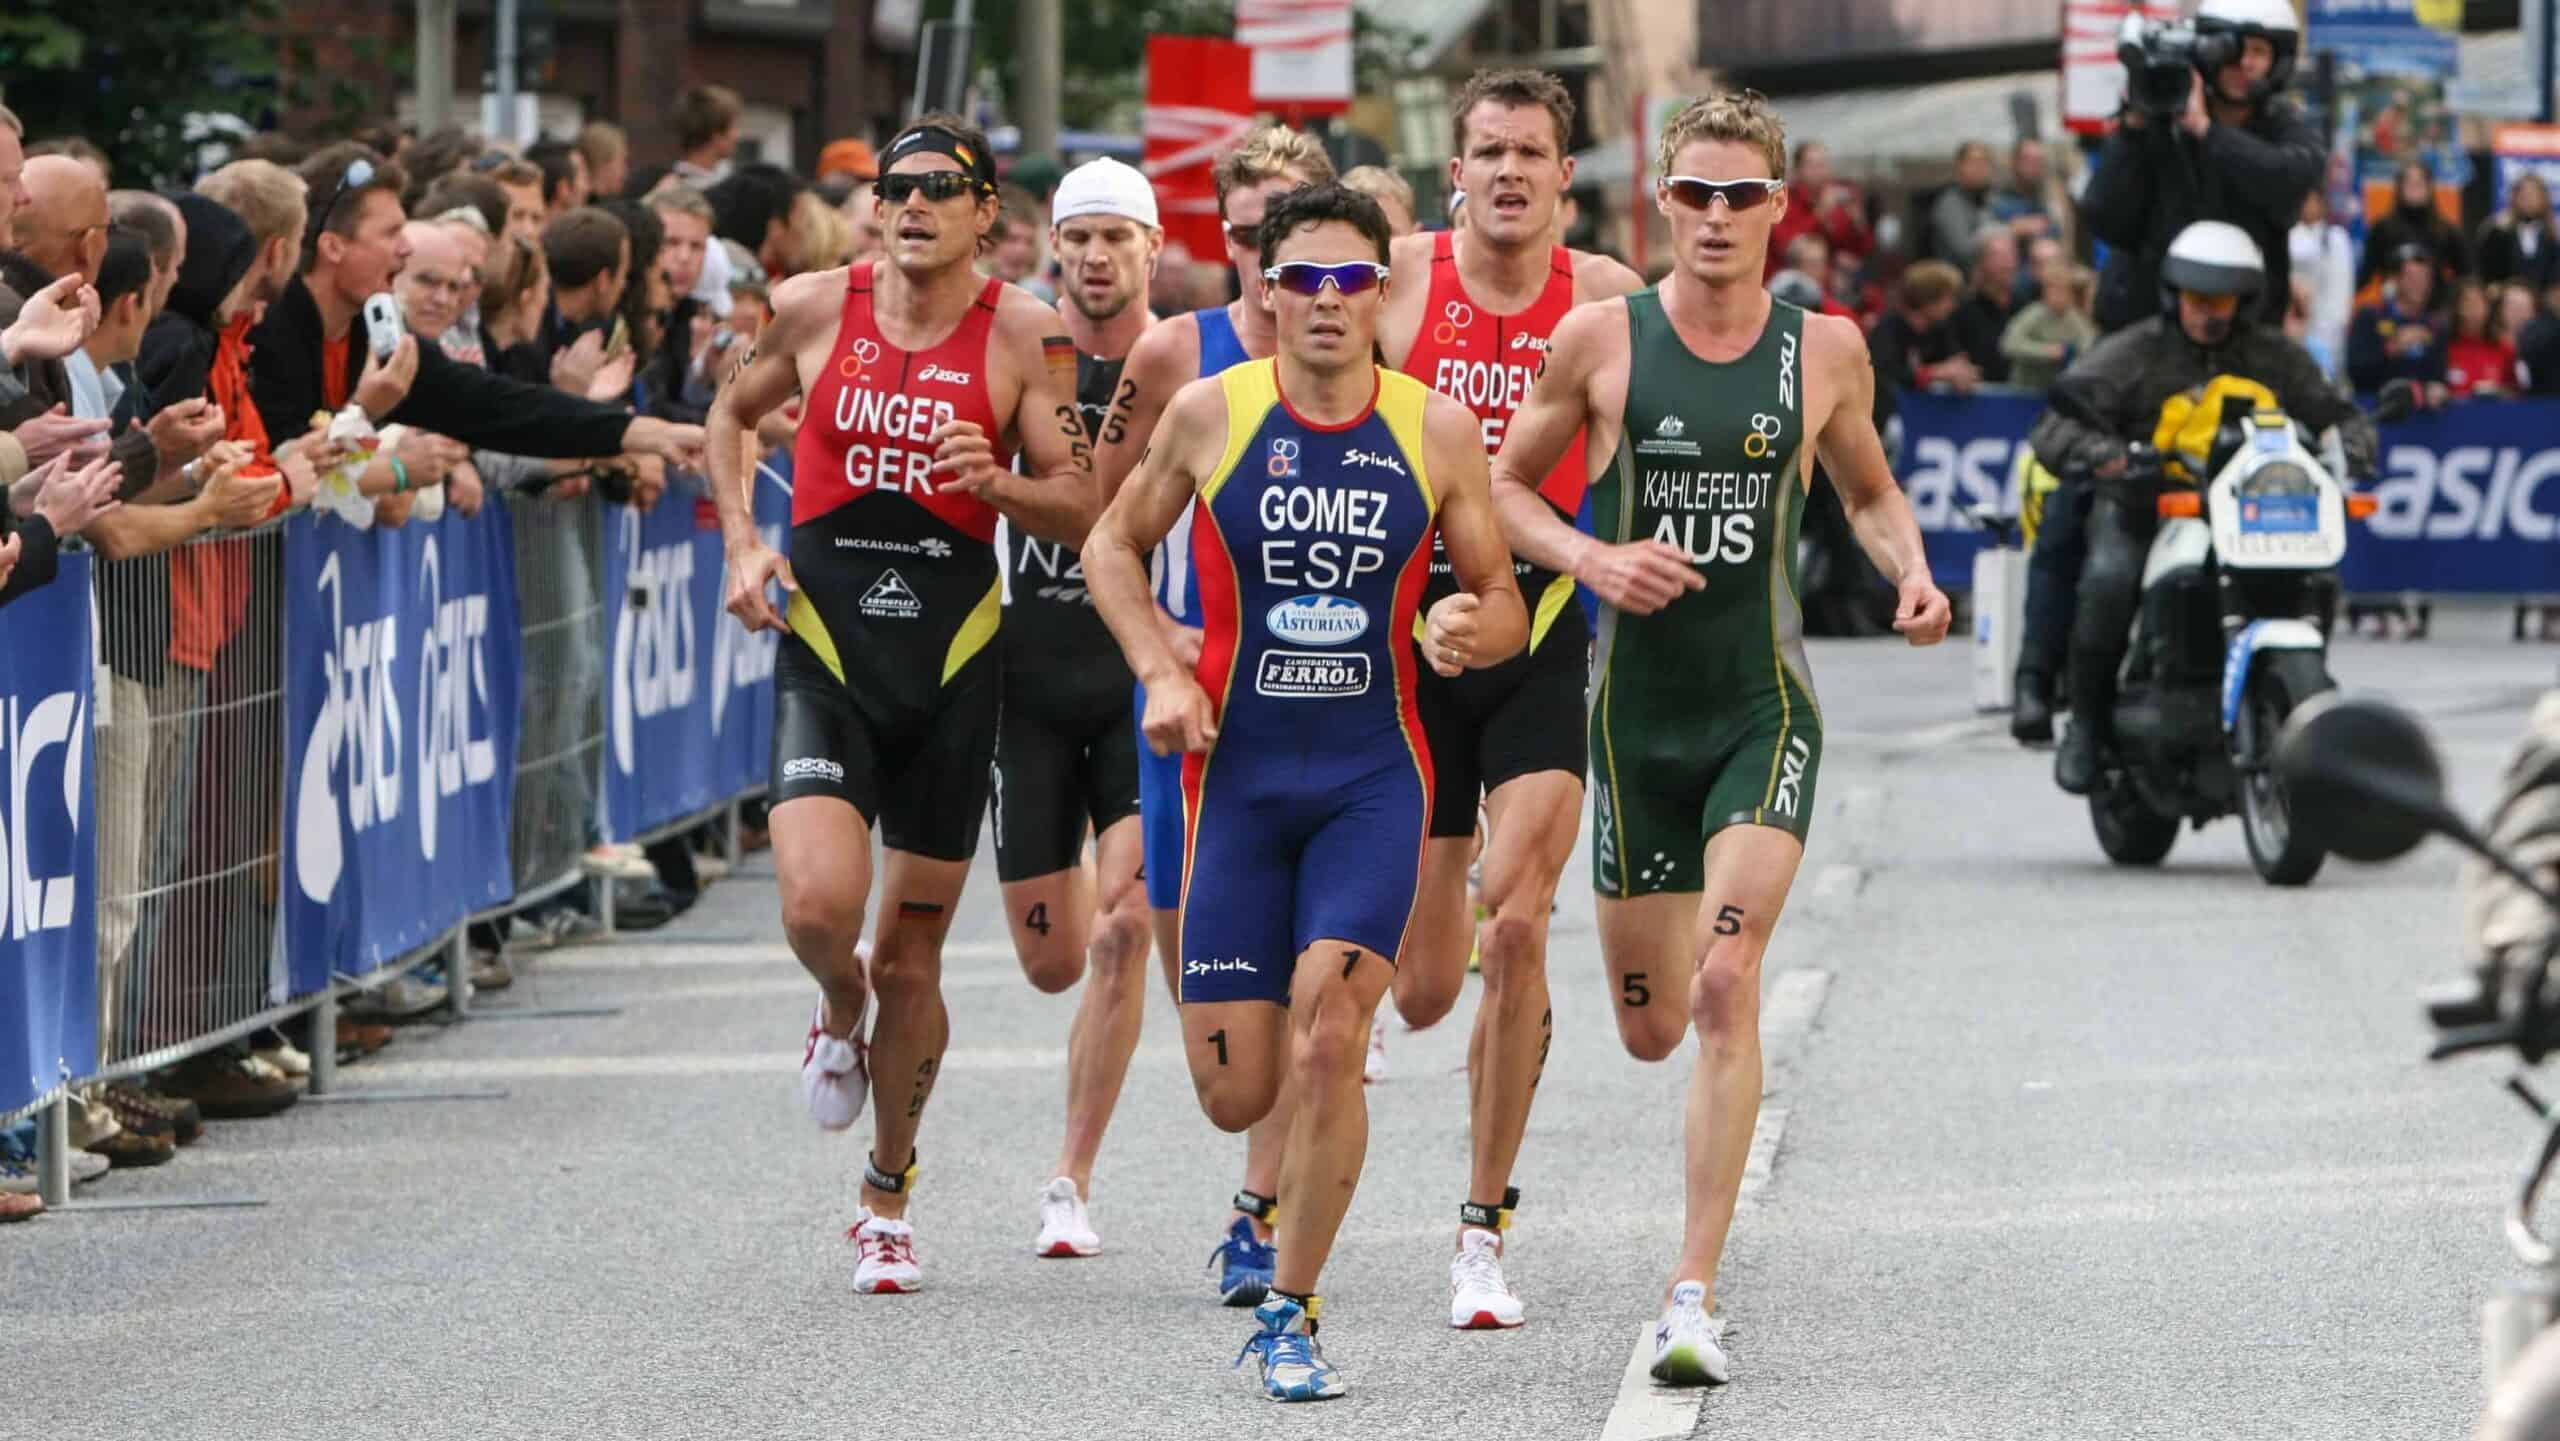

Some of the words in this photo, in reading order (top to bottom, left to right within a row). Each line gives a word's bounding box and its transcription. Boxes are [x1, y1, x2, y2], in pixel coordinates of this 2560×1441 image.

[1435, 358, 1535, 410] FRODEN
[1778, 331, 1796, 411] 2XU
[845, 443, 934, 496] GER
[1643, 469, 1771, 510] KAHLEFELDT
[2366, 445, 2560, 541] asic
[1260, 485, 1388, 540] GOMEZ
[1652, 513, 1755, 564] AUS
[1262, 540, 1384, 589] ESP
[1276, 609, 1361, 633] ASTURIANA
[1265, 663, 1360, 685] FERROL
[1774, 735, 1811, 819] 2XU
[1025, 901, 1051, 936] 4
[1713, 904, 1745, 936] 5
[1623, 972, 1650, 1008] 5
[1207, 1029, 1229, 1065] 1
